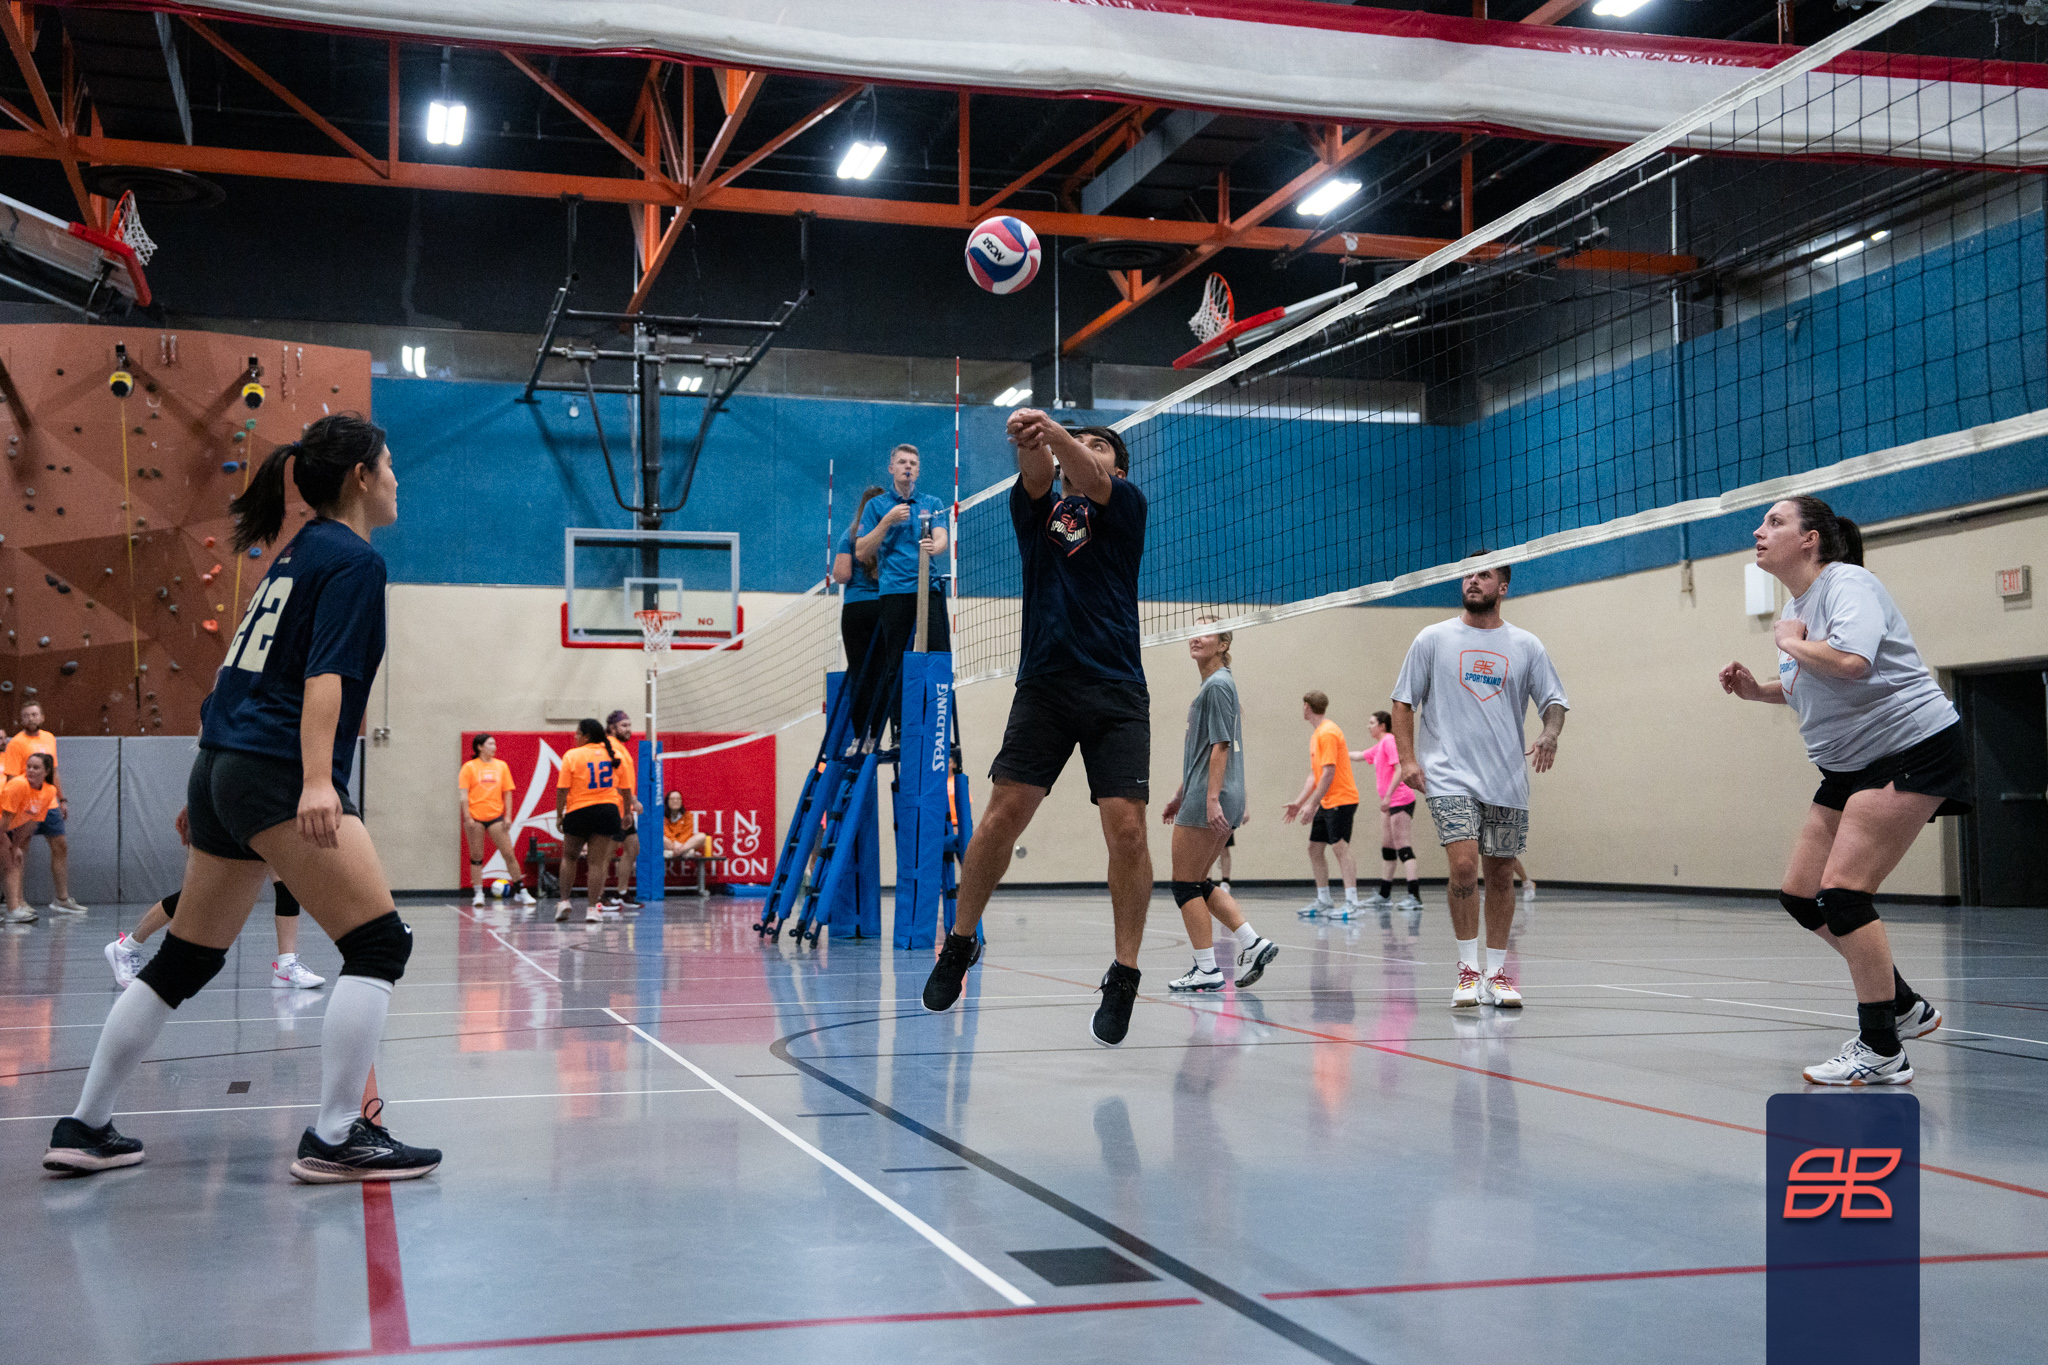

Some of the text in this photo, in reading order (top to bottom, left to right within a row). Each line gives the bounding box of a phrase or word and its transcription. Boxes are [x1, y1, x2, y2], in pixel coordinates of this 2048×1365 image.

[982, 236, 1005, 262] NCAA
[2002, 570, 2020, 591] EXIT
[223, 576, 293, 673] 22
[697, 617, 714, 626] NO
[1464, 672, 1502, 686] SPORTSKIND
[932, 683, 949, 771] SPALDING
[587, 761, 613, 789] 12
